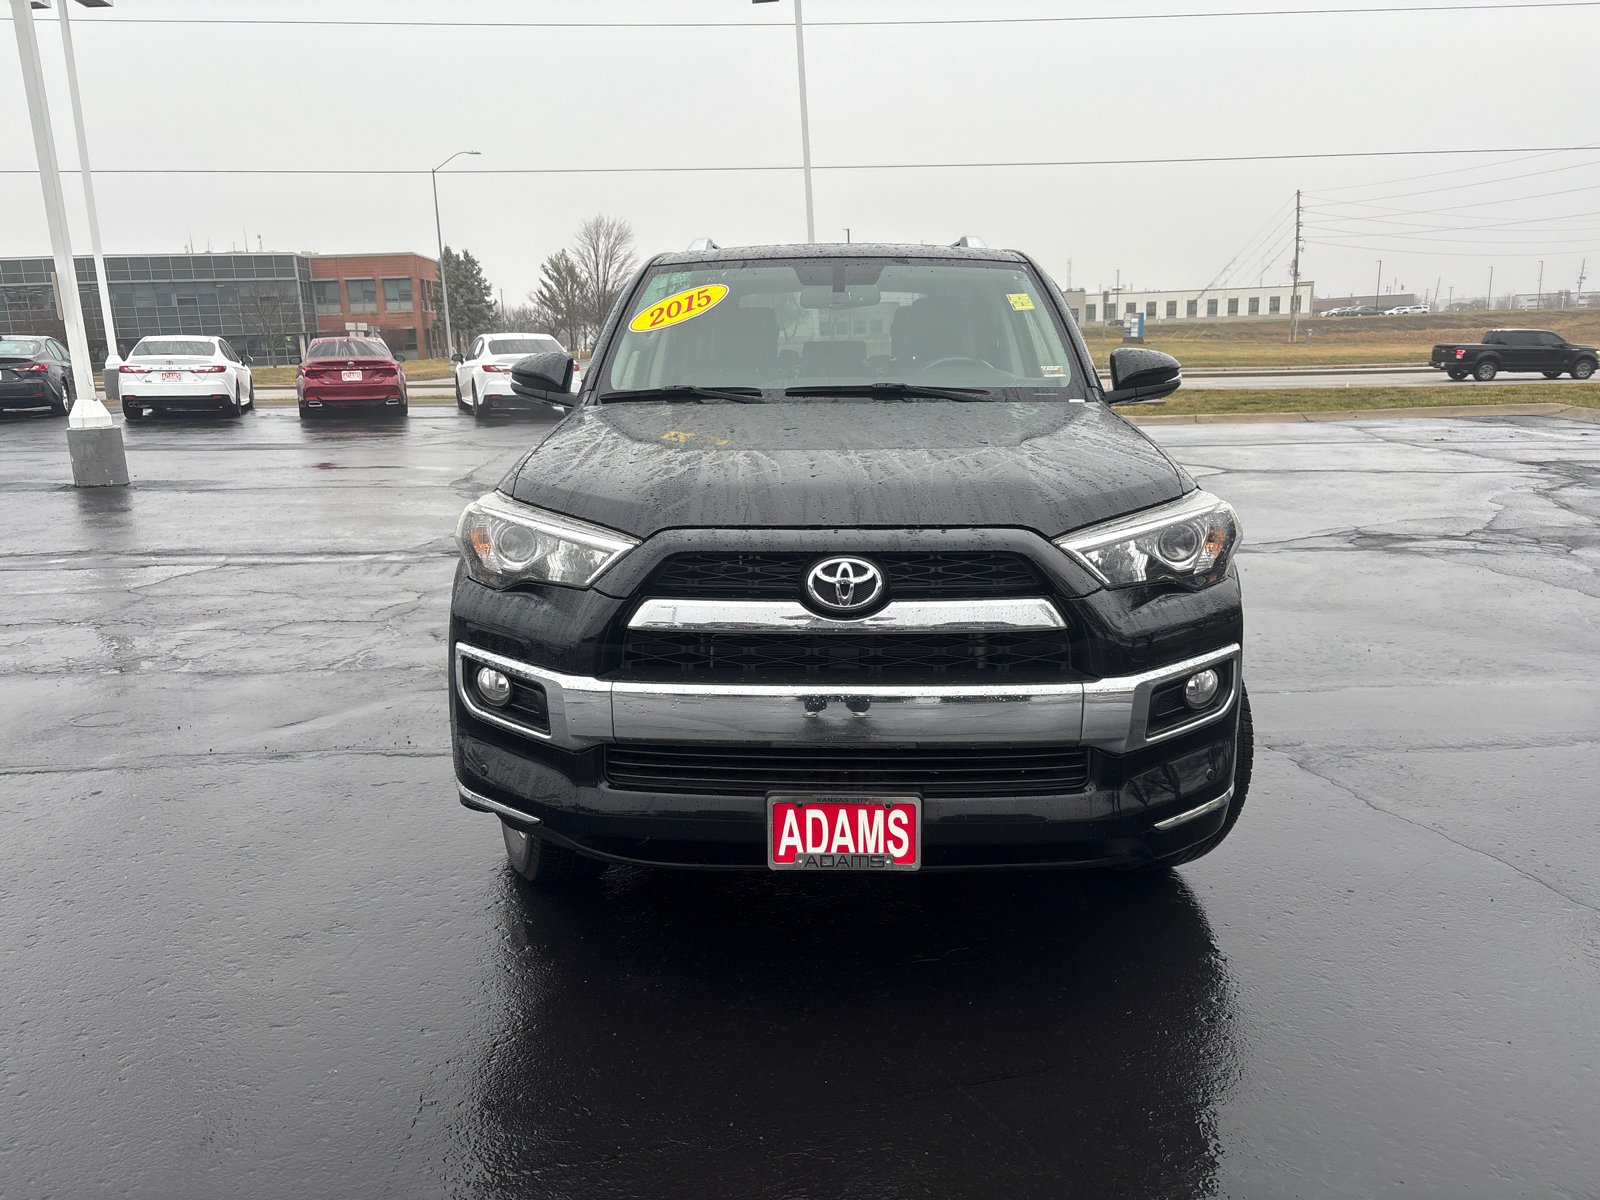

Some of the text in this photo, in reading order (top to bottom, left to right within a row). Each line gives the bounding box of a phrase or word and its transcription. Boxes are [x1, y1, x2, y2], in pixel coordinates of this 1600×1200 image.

[649, 288, 712, 328] 2015
[778, 809, 910, 858] ADAMS
[804, 855, 885, 868] ADAMS
